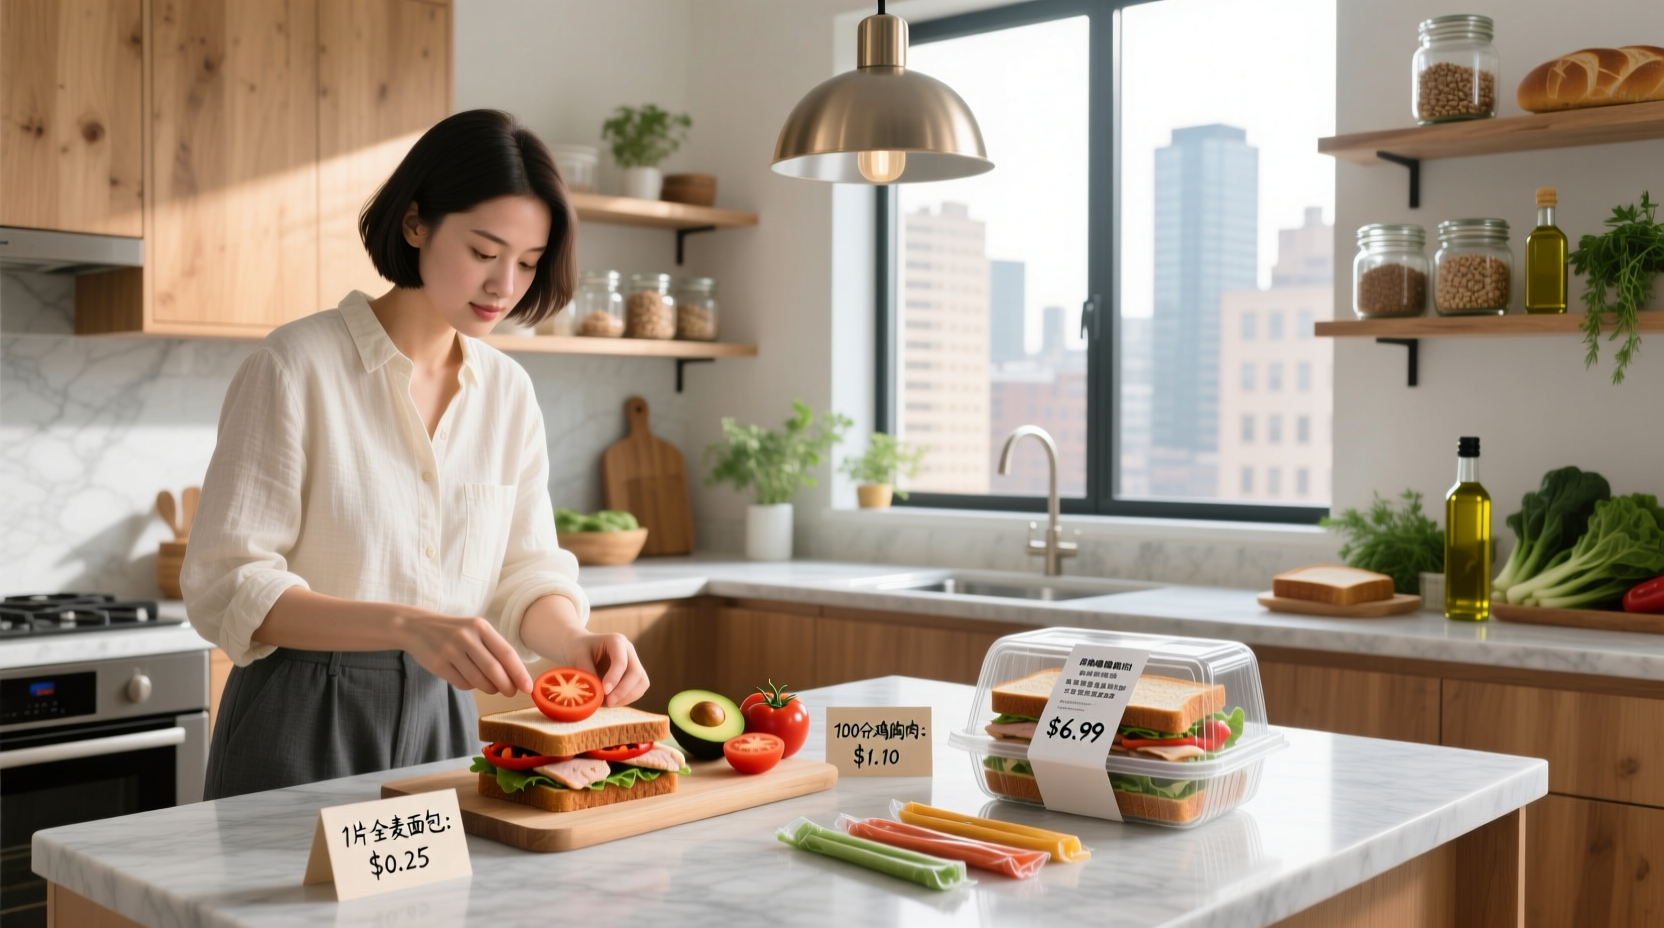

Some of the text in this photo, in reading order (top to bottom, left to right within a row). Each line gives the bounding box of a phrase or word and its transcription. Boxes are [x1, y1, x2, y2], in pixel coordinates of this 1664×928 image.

[1046, 716, 1105, 743] $6.99
[853, 743, 900, 769] $1.10
[341, 809, 451, 848] 1片全麦面包:
[369, 846, 430, 881] $0.25
